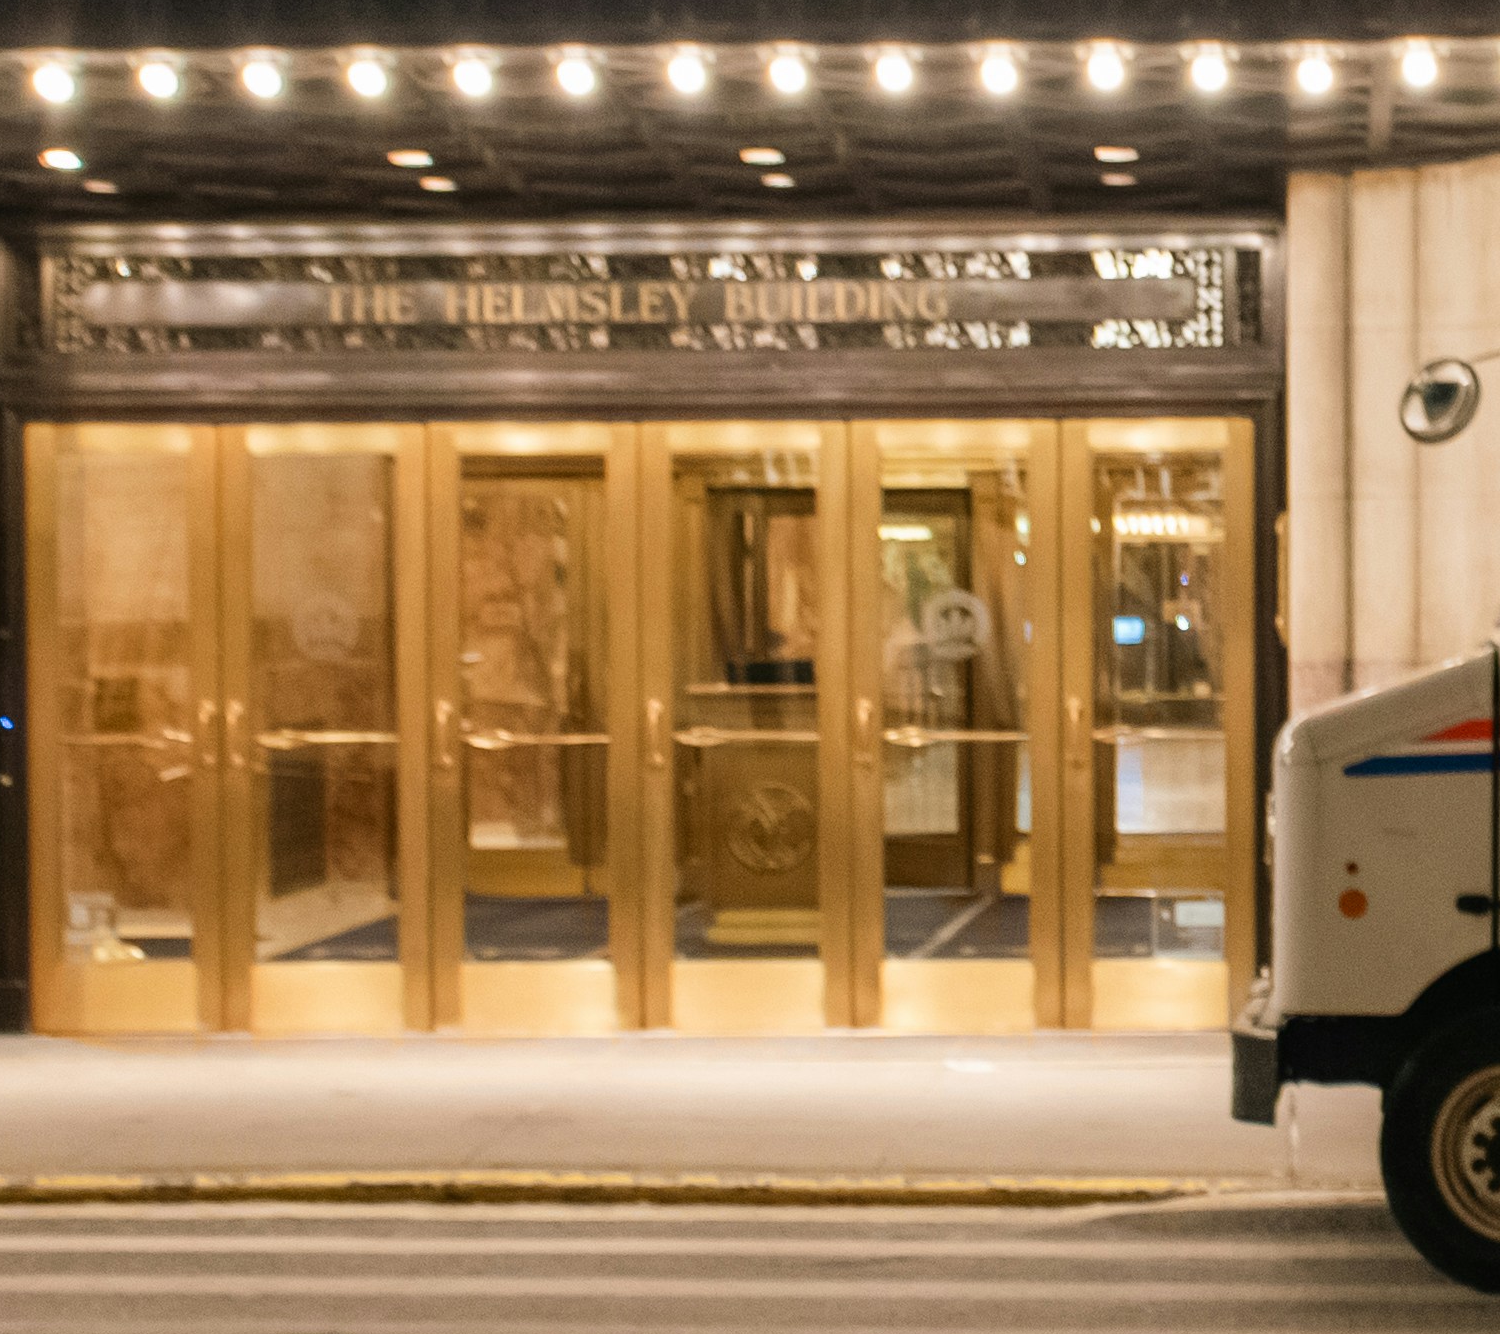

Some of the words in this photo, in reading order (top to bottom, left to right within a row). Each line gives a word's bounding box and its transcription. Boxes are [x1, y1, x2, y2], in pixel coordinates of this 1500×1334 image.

[328, 283, 415, 325] THE
[443, 281, 698, 324] HELMSLEY
[722, 279, 950, 323] BUILDING
